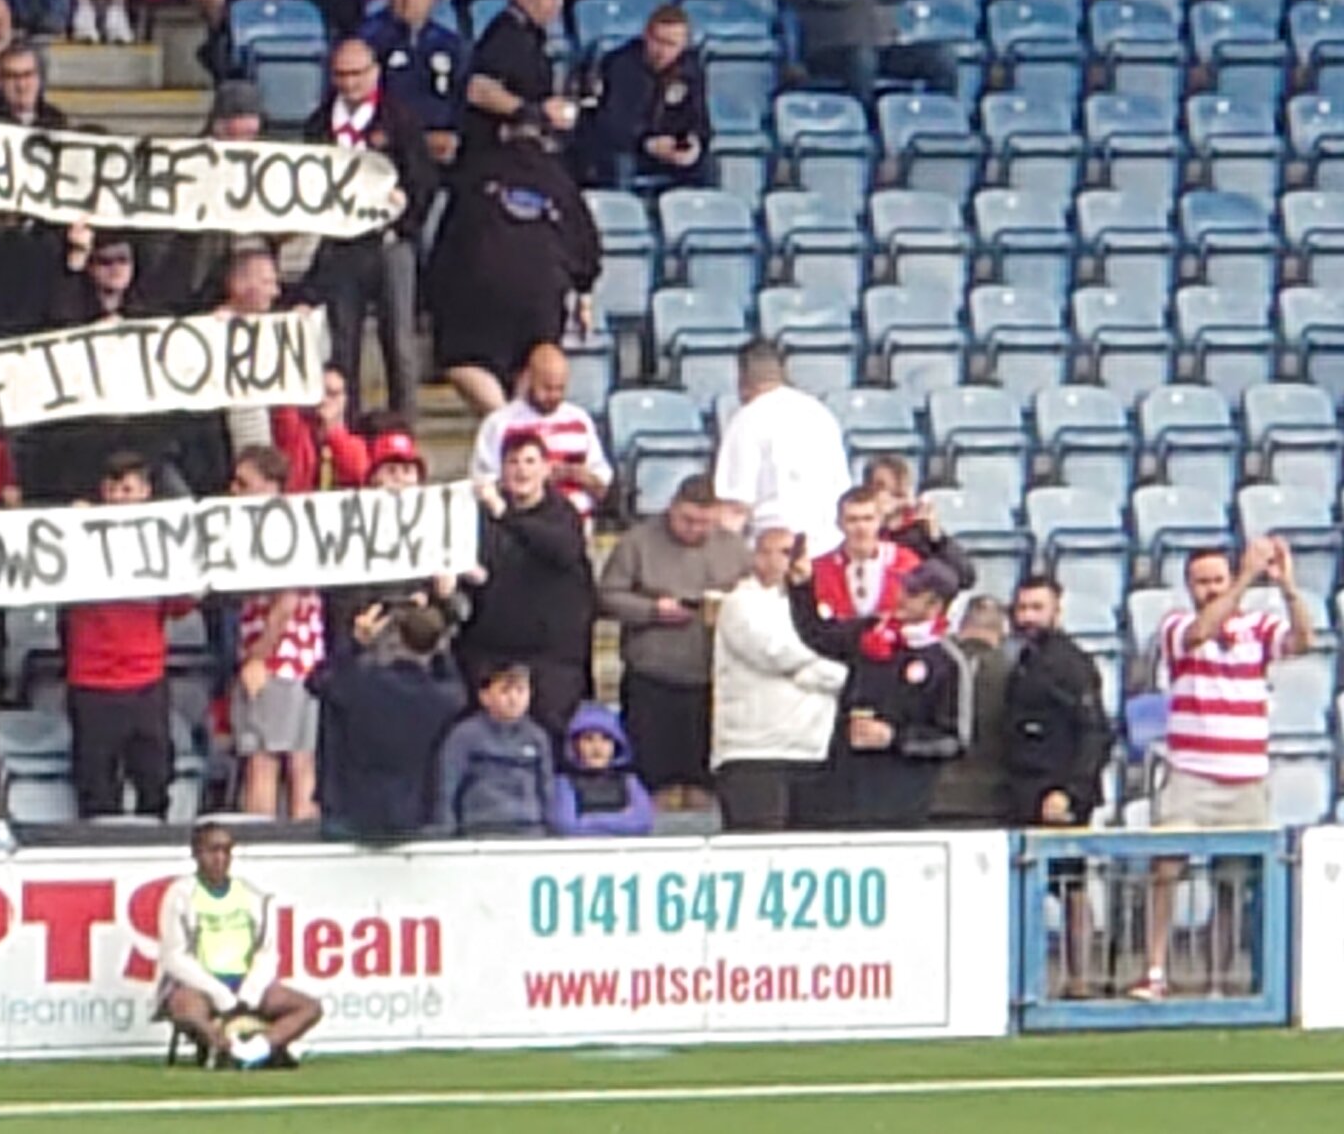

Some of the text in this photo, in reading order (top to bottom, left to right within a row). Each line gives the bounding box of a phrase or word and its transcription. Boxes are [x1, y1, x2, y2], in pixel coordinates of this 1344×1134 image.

[118, 322, 211, 398] TO
[226, 317, 307, 397] RUN
[82, 503, 237, 578] TIME
[240, 496, 299, 566] TO
[530, 867, 887, 937] 0141 647 4200
[276, 906, 443, 979] lean
[523, 958, 894, 1012] www.ptsclean.com
